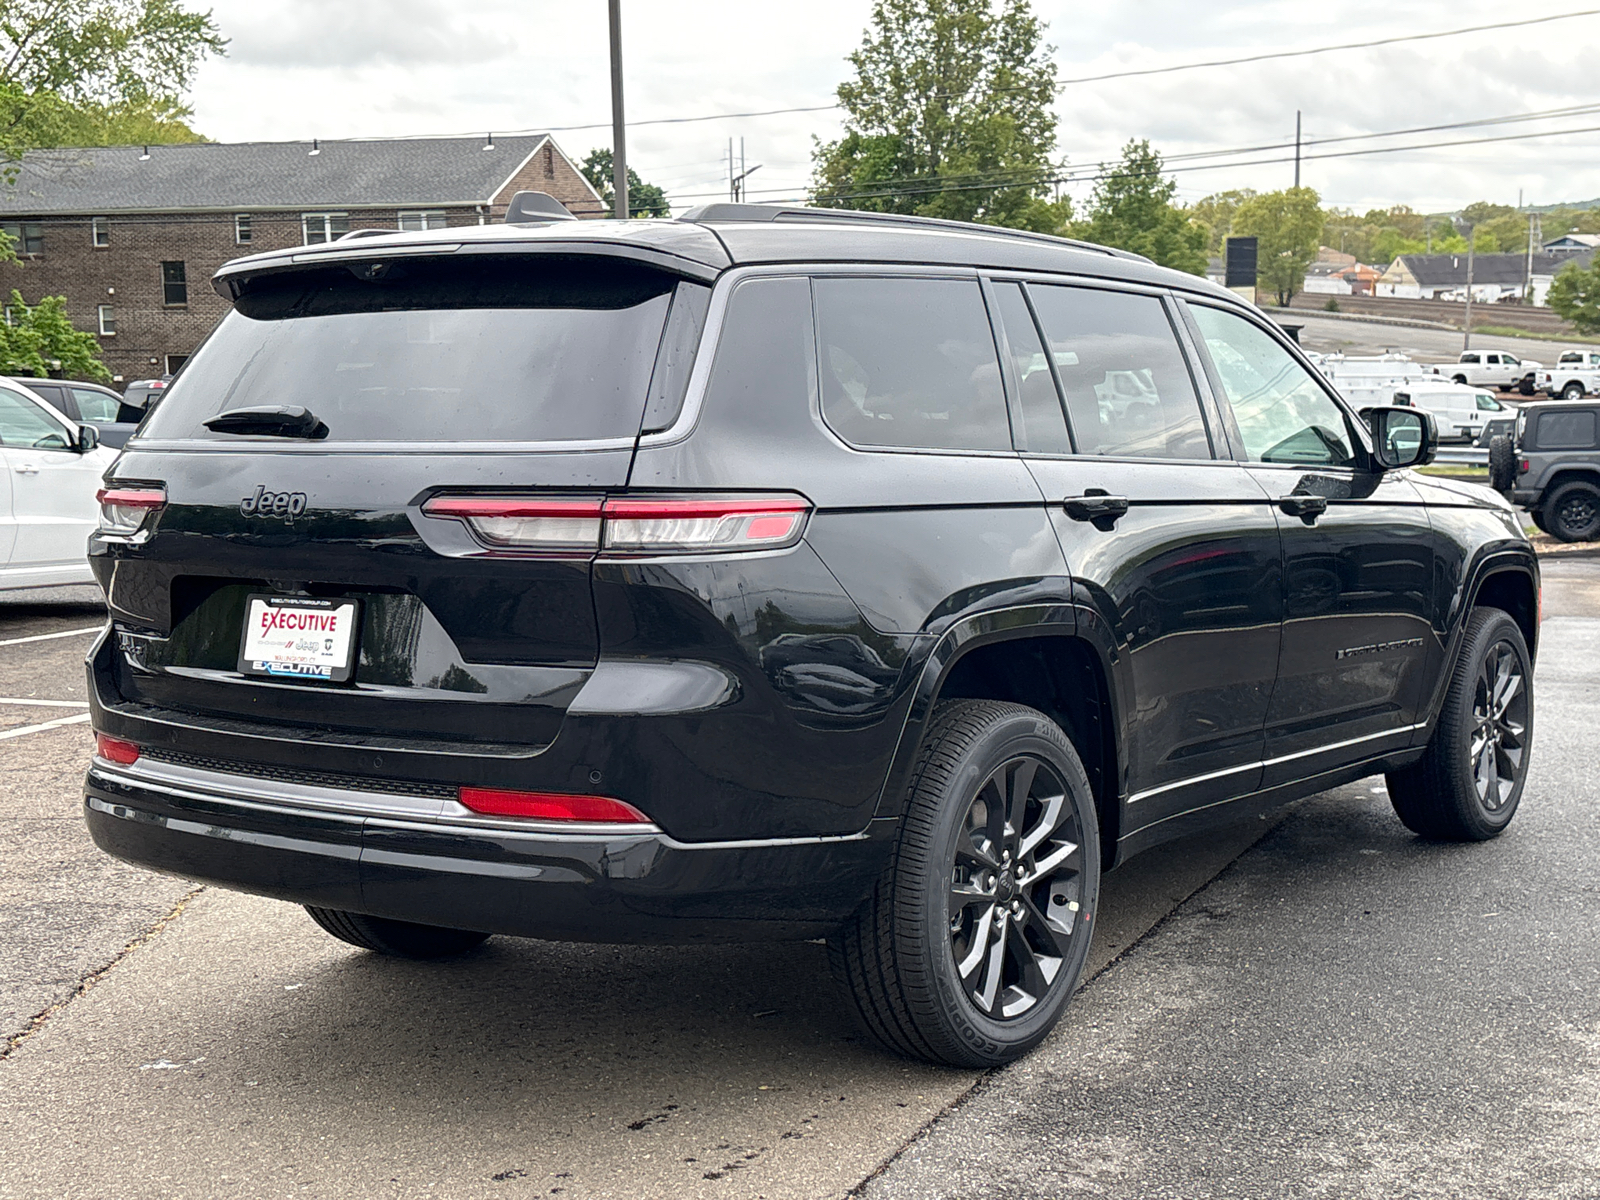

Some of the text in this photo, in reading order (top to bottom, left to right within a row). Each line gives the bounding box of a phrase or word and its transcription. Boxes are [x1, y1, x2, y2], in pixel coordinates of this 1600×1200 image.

[240, 484, 307, 526] Jeep
[261, 608, 337, 638] EXECUTIVE
[295, 638, 320, 653] Jeep
[252, 660, 332, 676] EXECUTIVE
